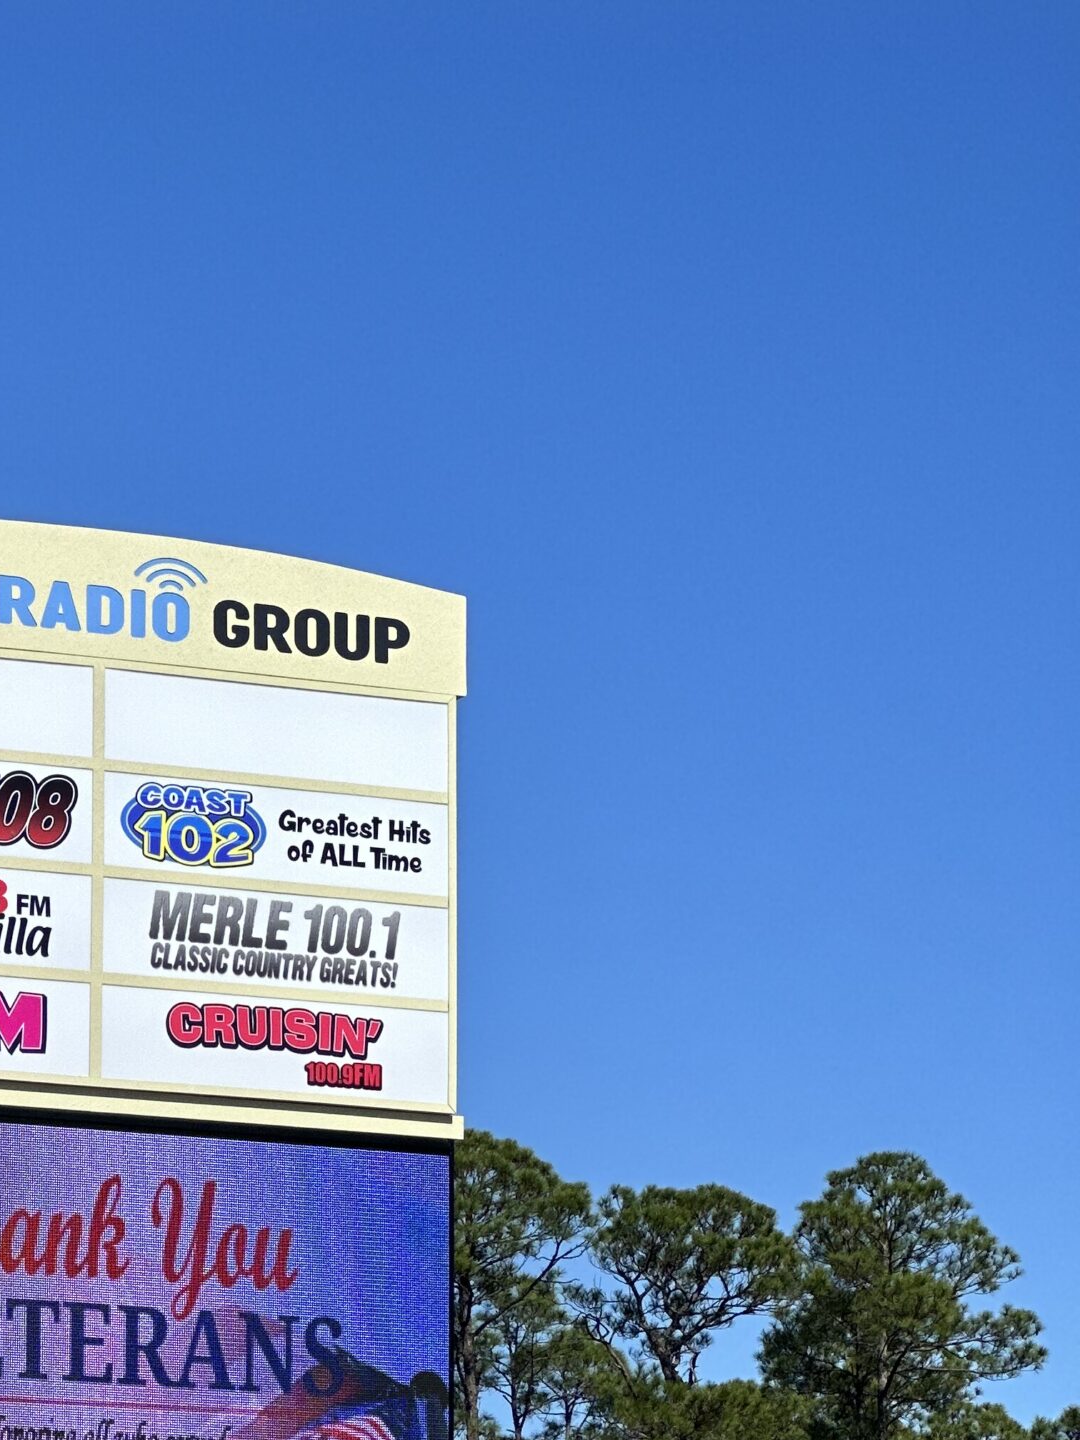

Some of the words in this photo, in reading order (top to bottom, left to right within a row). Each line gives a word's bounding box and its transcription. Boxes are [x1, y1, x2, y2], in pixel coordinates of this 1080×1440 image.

[213, 600, 411, 664] GROUP
[136, 782, 252, 816] COAST
[134, 810, 255, 868] 102
[278, 810, 383, 840] Greatest
[388, 819, 431, 845] Hits
[287, 840, 314, 862] of
[320, 844, 366, 868] ALL
[370, 847, 422, 873] Time
[16, 894, 51, 918] FM
[149, 889, 293, 951] MERLE
[304, 903, 401, 960] 100.1
[150, 942, 229, 975] CLASSIC
[232, 948, 318, 982] COUNTRY
[319, 960, 398, 988] GREATS!
[166, 1001, 383, 1060] CRUISIN'
[304, 1061, 382, 1091] 100.9FM
[152, 1176, 298, 1321] You
